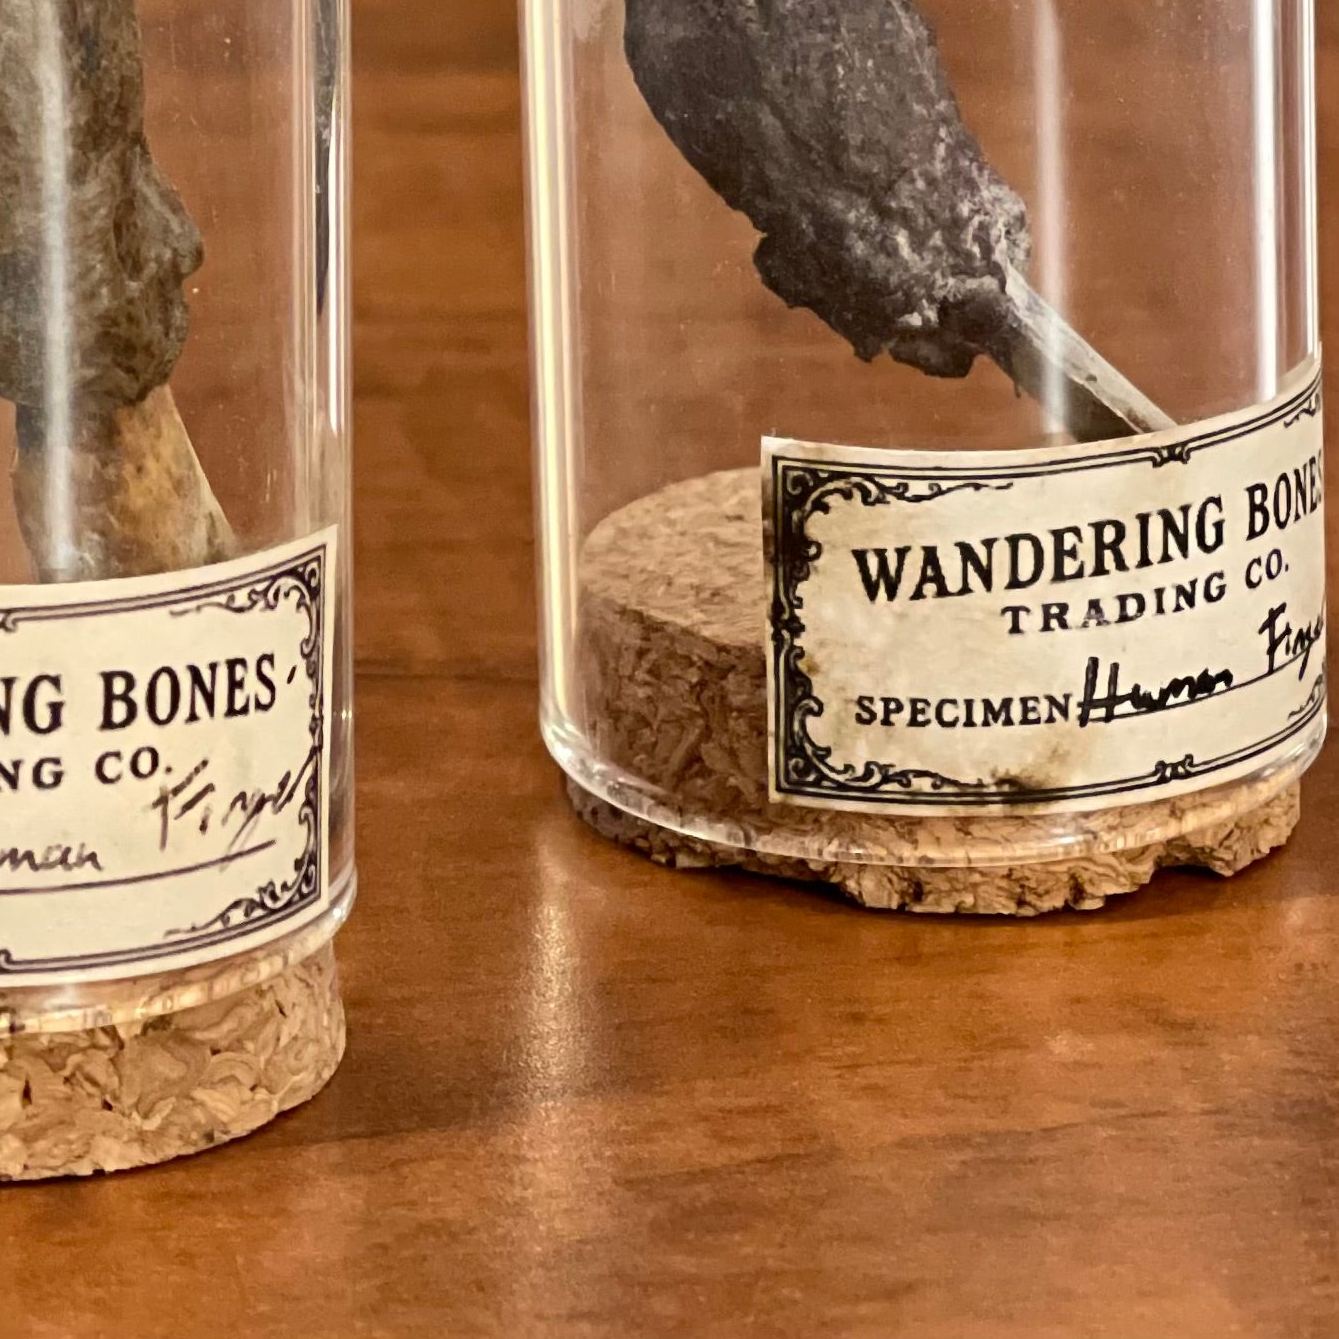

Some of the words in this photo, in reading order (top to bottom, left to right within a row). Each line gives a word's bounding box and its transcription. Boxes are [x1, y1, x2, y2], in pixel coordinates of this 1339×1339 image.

[852, 494, 1225, 602] WANDERING
[1001, 572, 1228, 635] TRADING
[1245, 548, 1289, 590] CO.
[99, 651, 277, 732] BONES
[94, 745, 174, 784] CO.
